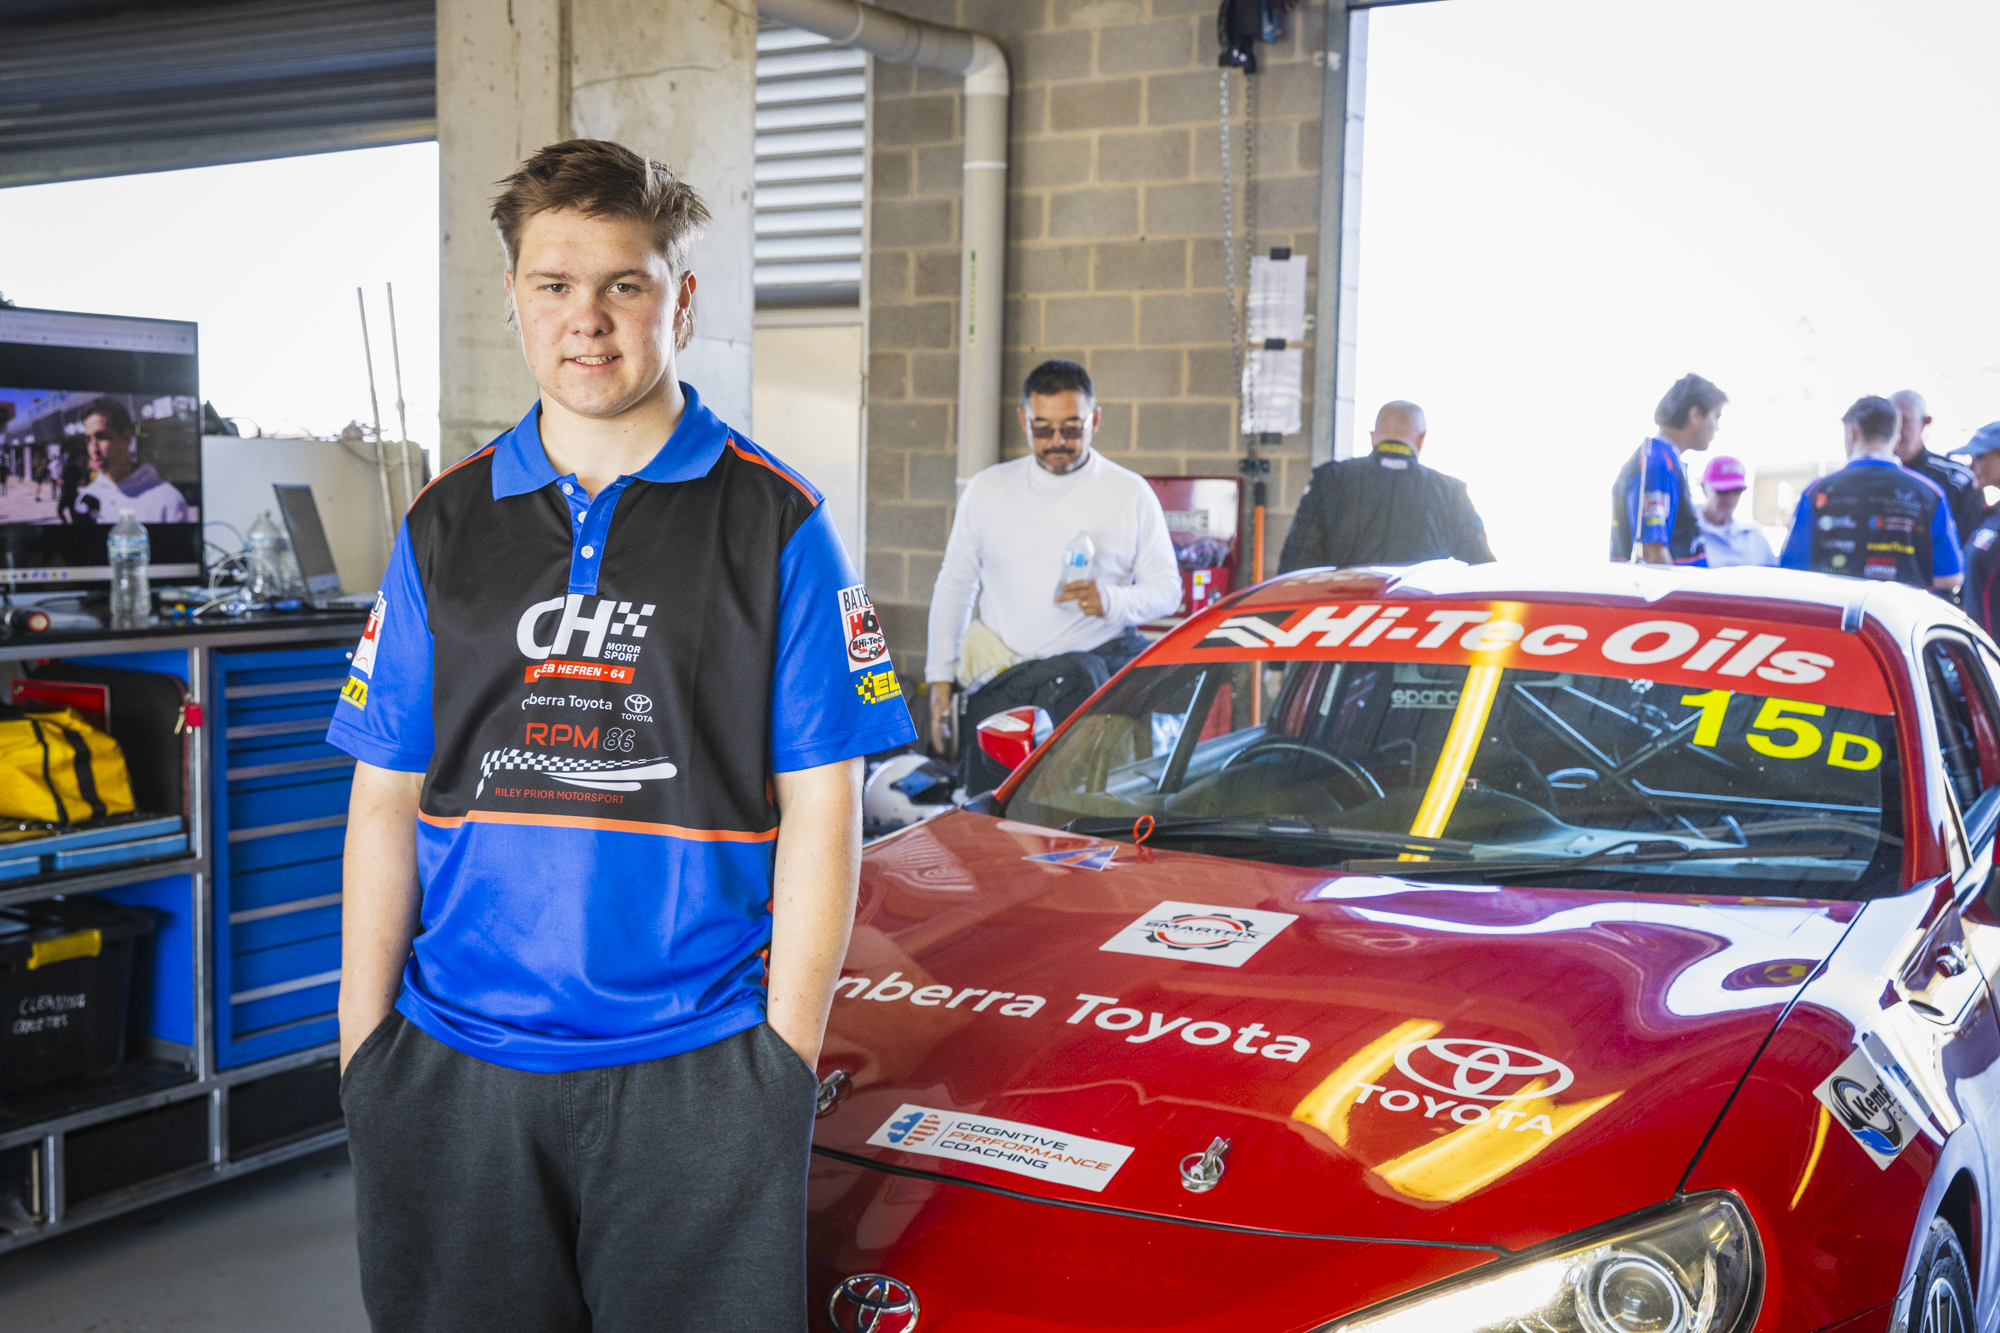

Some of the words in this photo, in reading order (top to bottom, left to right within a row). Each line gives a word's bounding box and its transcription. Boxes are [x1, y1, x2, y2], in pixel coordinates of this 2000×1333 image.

[516, 593, 617, 660] CH
[606, 642, 642, 654] MOTOR
[858, 636, 883, 648] Hi-Tec
[1285, 604, 1590, 657] Hi-Tec
[1600, 618, 1836, 687] Oils
[603, 650, 640, 662] SPORT
[557, 664, 602, 677] HEFREN
[610, 669, 626, 679] 64
[568, 695, 613, 711] Toyota
[621, 713, 653, 723] TOYOTA
[525, 722, 599, 748] RPM
[603, 727, 636, 753] 86
[495, 787, 522, 797] RILEY
[524, 788, 555, 799] PRIOR
[556, 790, 625, 804] MOTORSPORT
[1144, 921, 1258, 939] SMARTFIX
[1066, 993, 1311, 1063] Toyota
[1354, 1082, 1553, 1135] TOYOTA
[955, 1122, 1068, 1151] COGNITIVE
[939, 1140, 1049, 1170] COACHING
[947, 1131, 1112, 1171] PERFORMANCE
